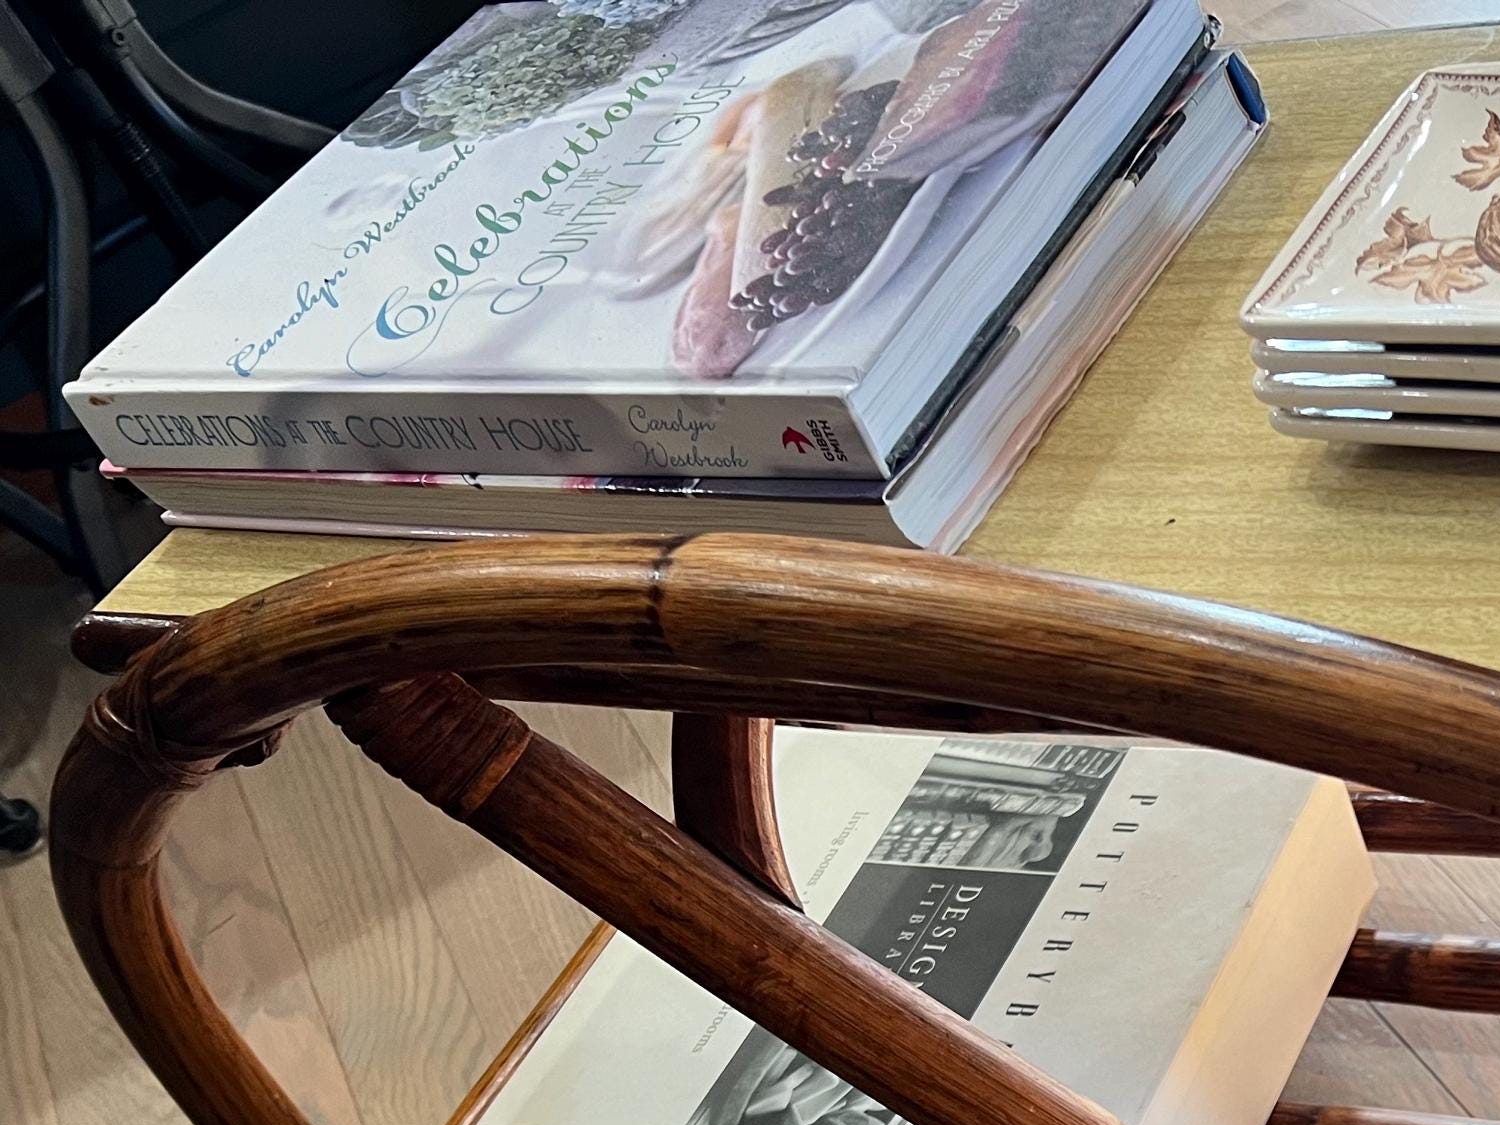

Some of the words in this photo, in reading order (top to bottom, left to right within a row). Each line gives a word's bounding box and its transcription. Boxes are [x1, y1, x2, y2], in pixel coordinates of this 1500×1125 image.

[490, 181, 643, 315] COUNTRY
[622, 76, 747, 166] HOUSE
[542, 200, 576, 217] AT
[564, 166, 612, 192] THE
[345, 52, 679, 377] Celebrations
[226, 267, 348, 378] Carolyn
[342, 143, 476, 260] Westbrook
[115, 413, 288, 448] CELEBRATIONS
[284, 419, 309, 446] AT
[306, 419, 348, 446] THE
[344, 414, 478, 451] COUNTRY
[479, 415, 594, 453] HOUSE
[627, 404, 716, 442] Carolyn
[806, 419, 835, 463] GIBBS
[818, 419, 849, 463] SMITH
[629, 440, 750, 469] Westbrook
[831, 810, 870, 846] living
[806, 847, 840, 888] rooms
